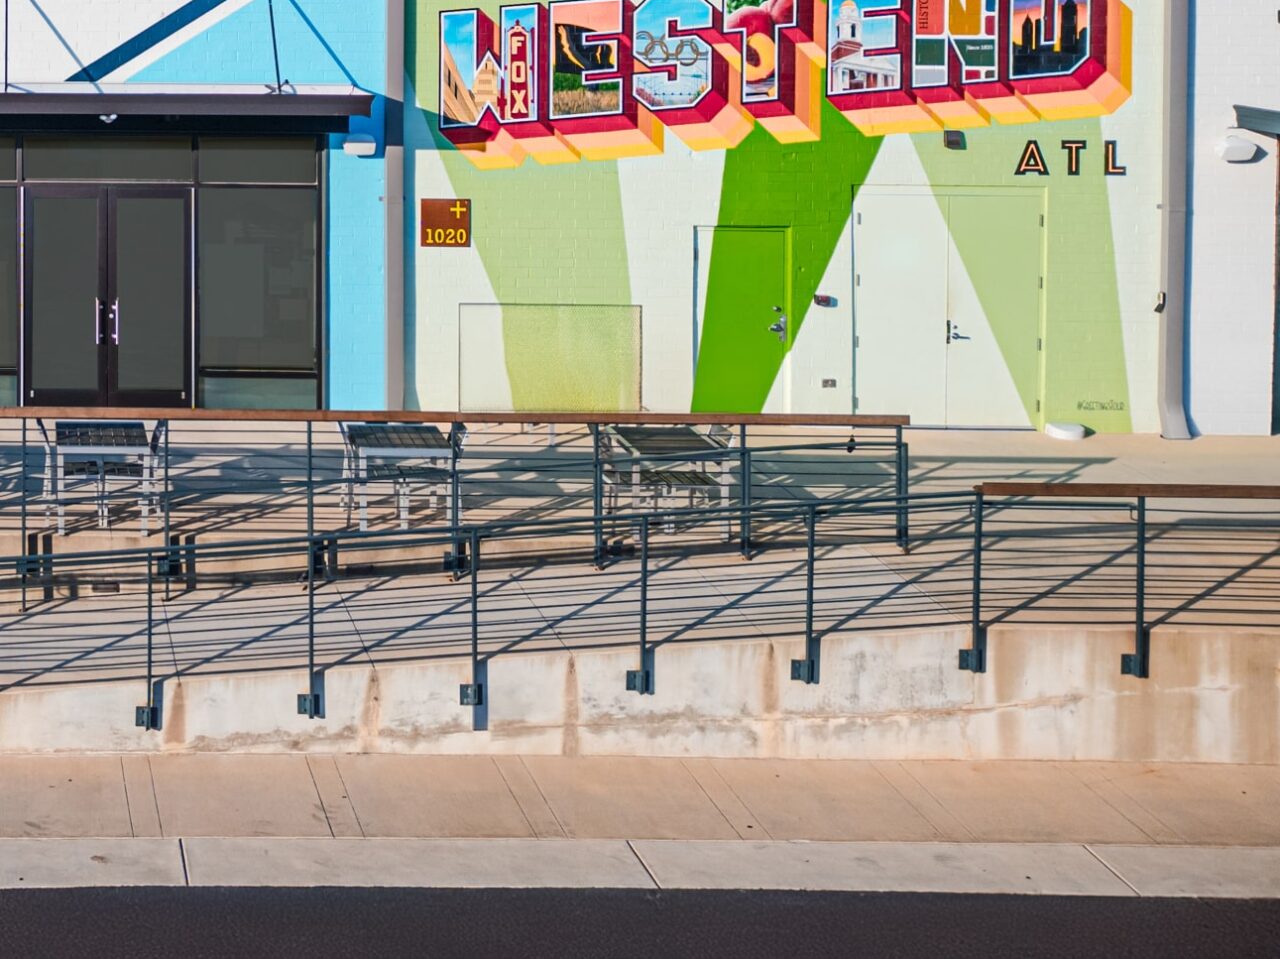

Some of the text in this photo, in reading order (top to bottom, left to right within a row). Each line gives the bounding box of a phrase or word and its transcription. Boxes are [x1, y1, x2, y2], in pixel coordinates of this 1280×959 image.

[511, 36, 528, 114] FOX
[1013, 139, 1127, 176] ATL
[425, 228, 467, 244] 1020
